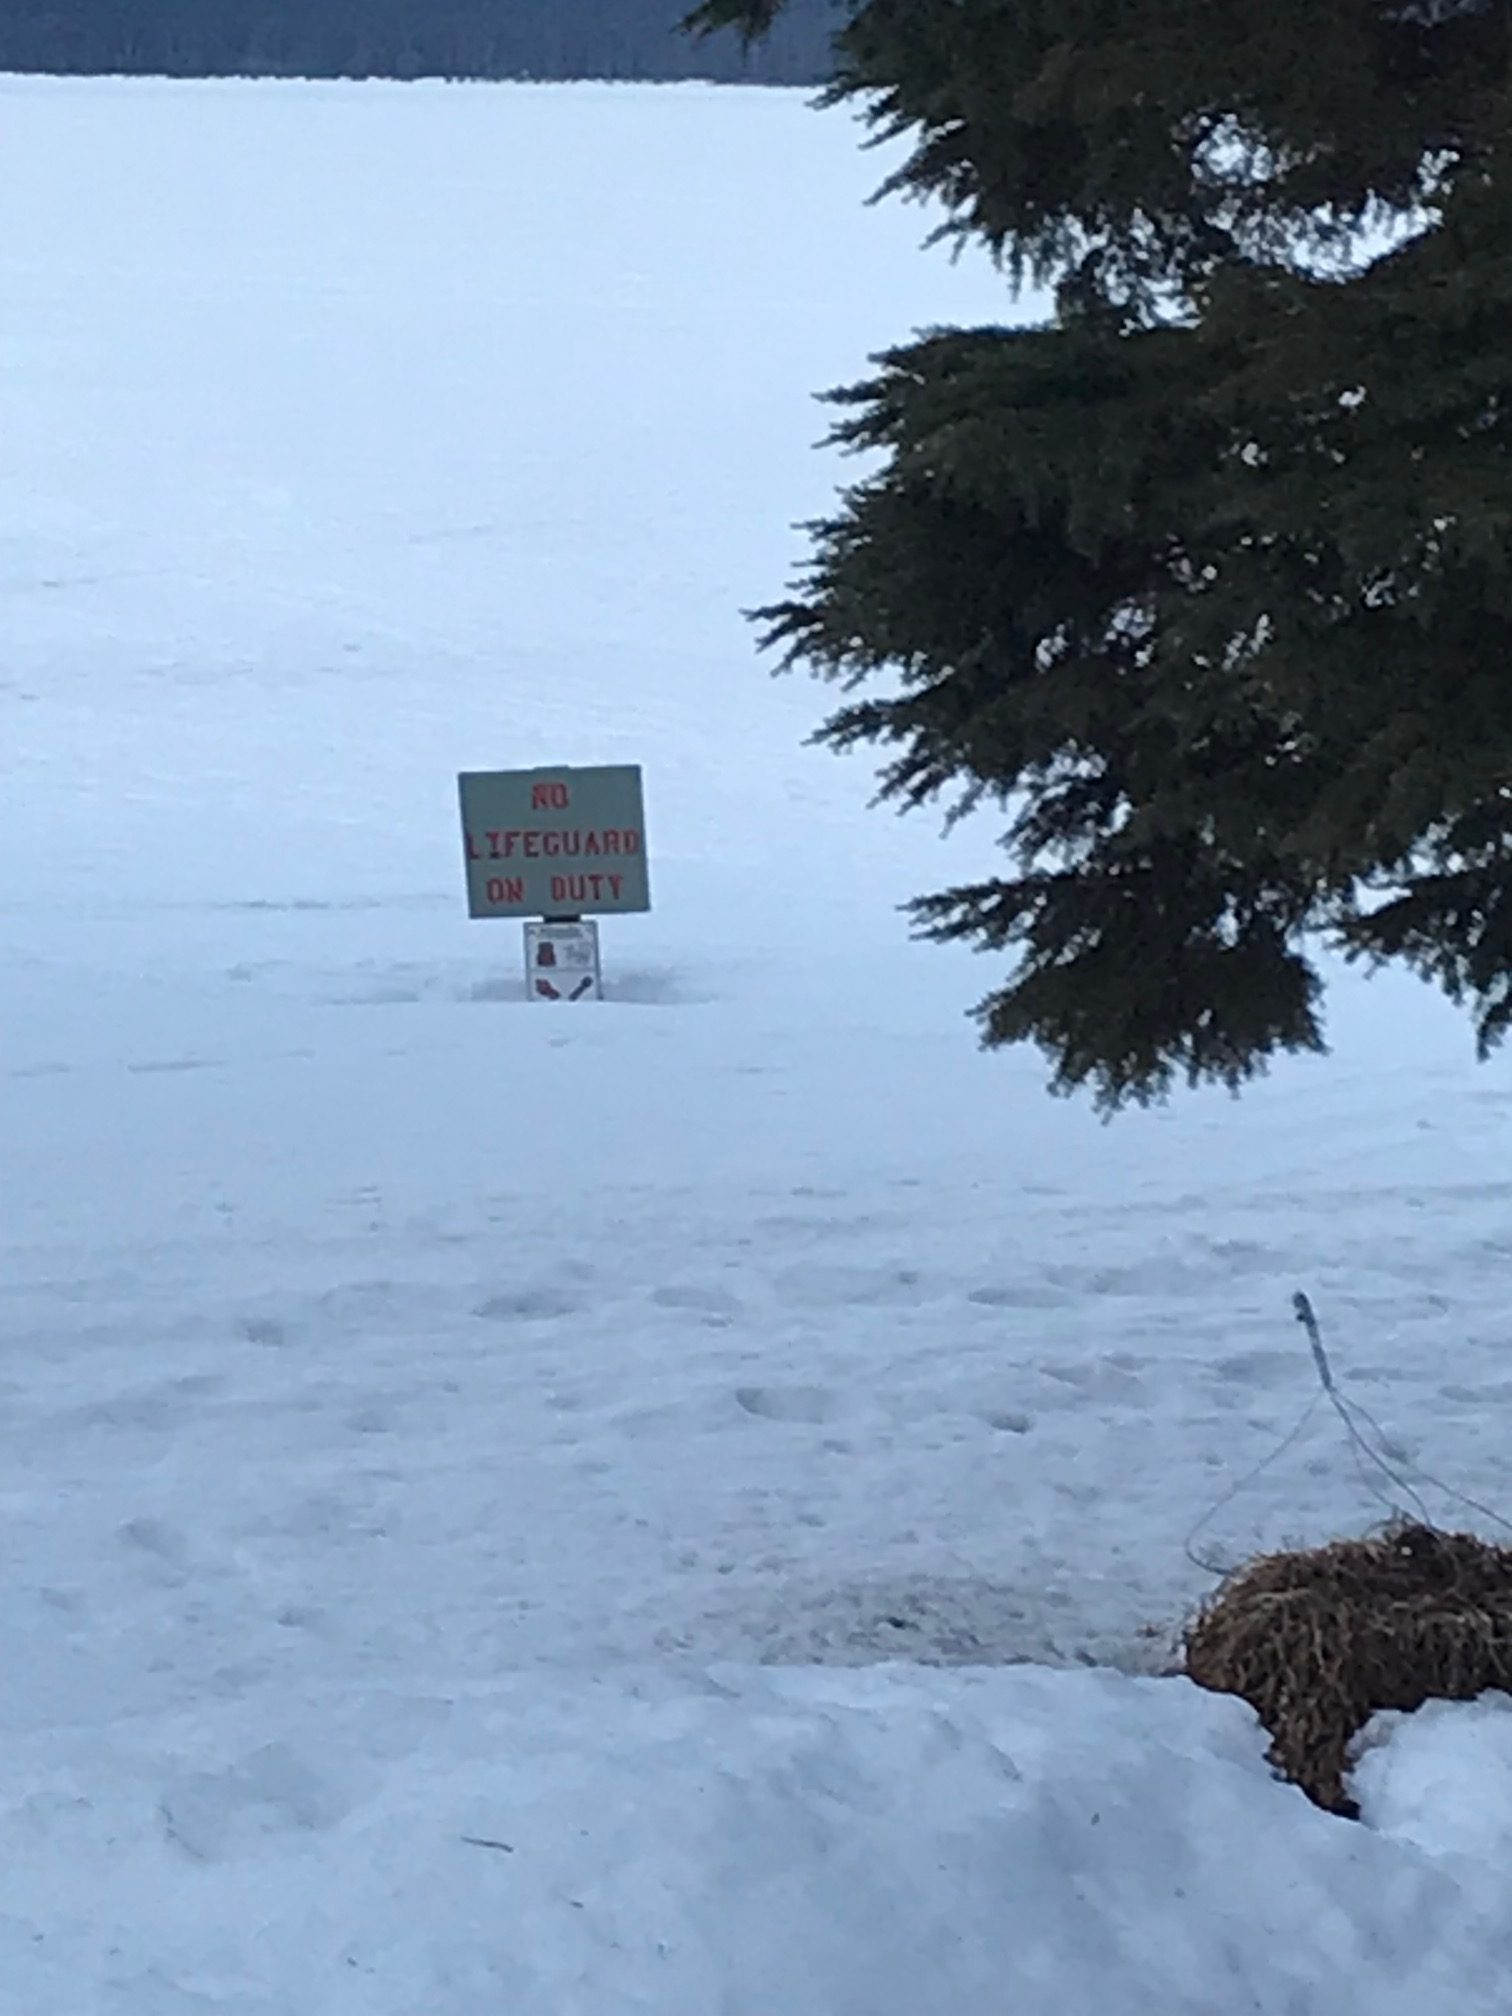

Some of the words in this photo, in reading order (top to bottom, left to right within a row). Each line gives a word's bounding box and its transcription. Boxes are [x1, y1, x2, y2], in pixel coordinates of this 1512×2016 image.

[532, 783, 569, 809] NO
[467, 829, 639, 859] LIFEGUARD
[486, 877, 524, 904] ON
[552, 874, 623, 902] DUTY
